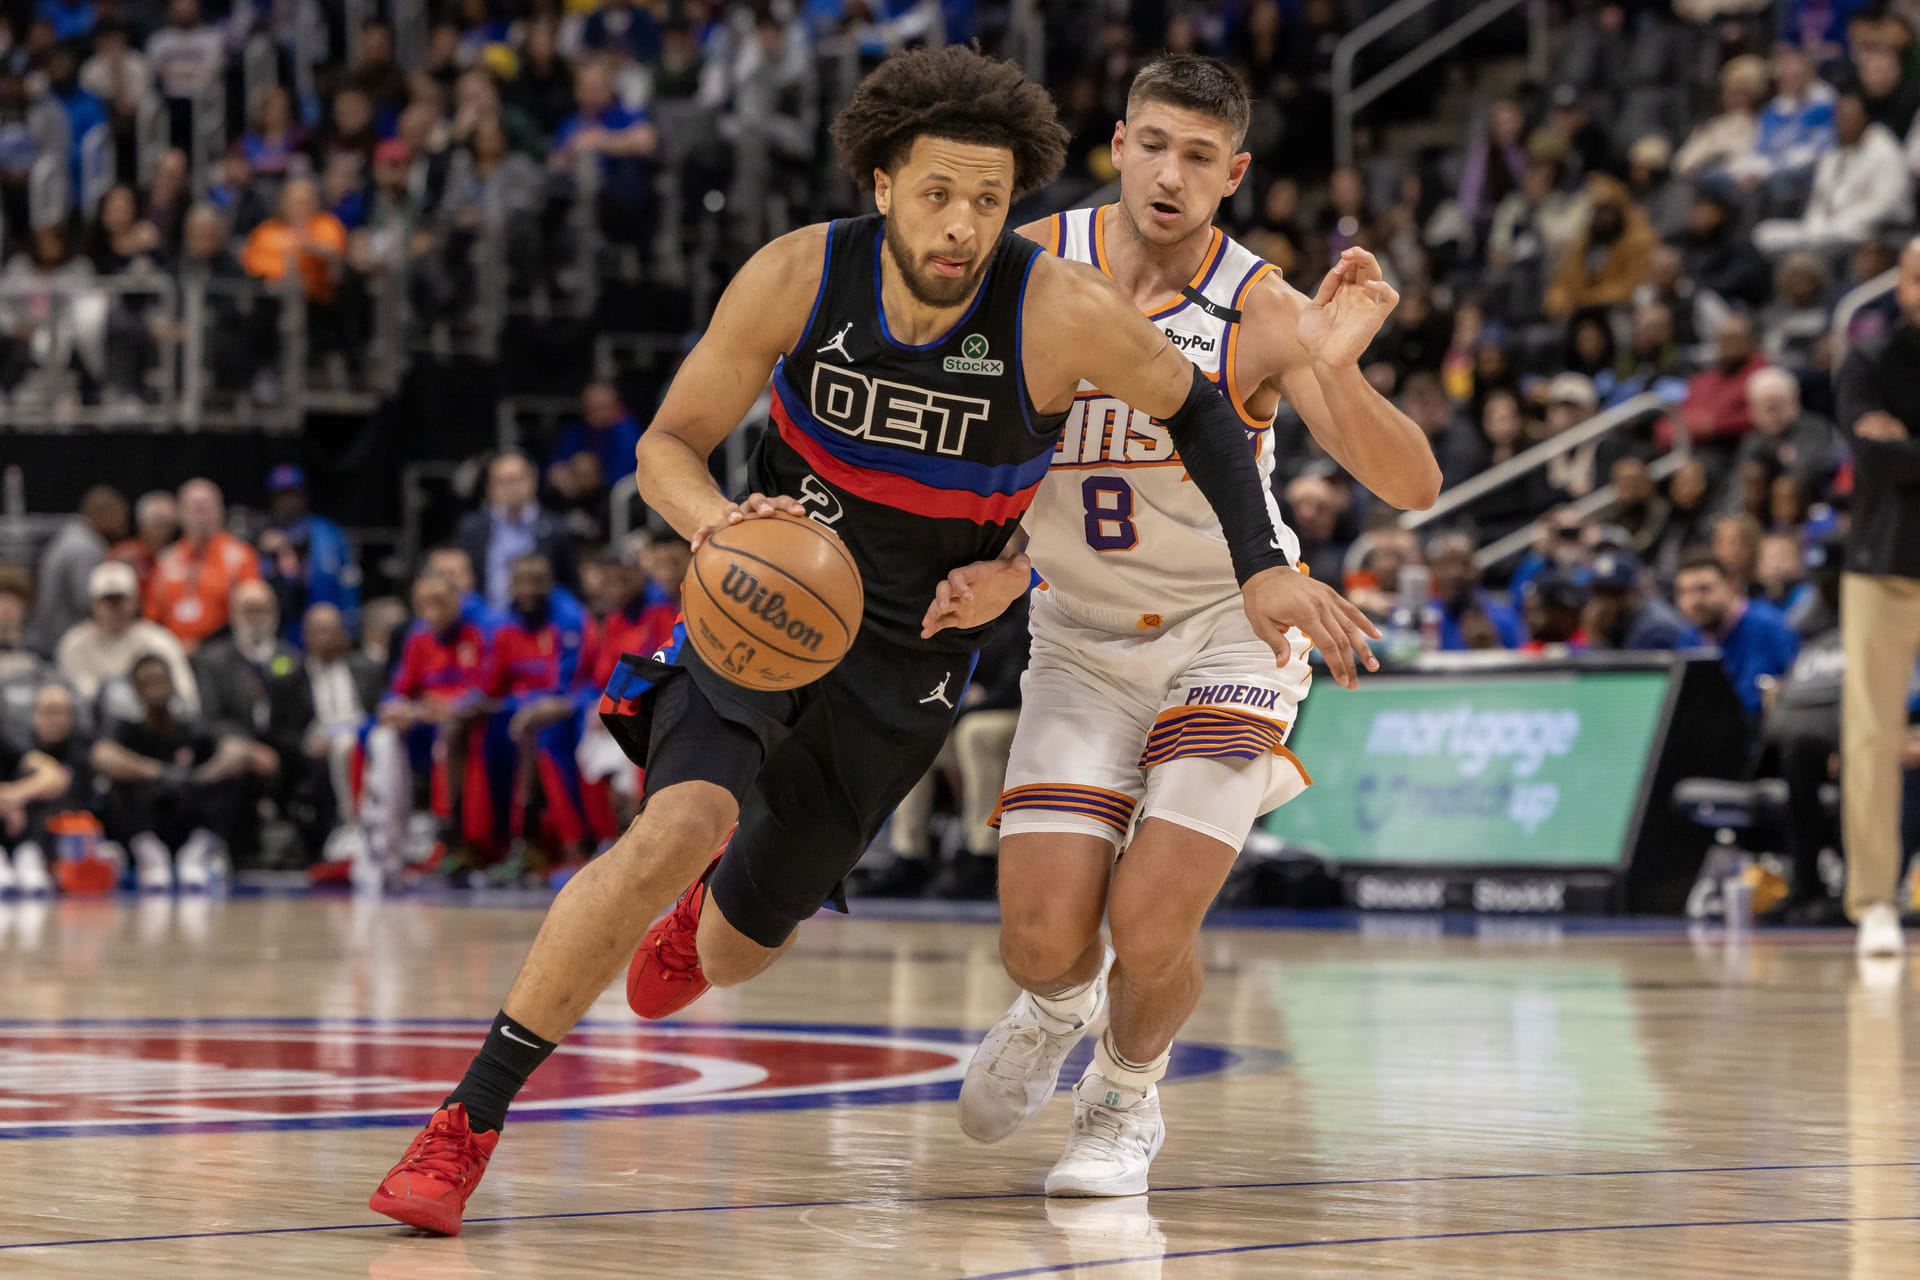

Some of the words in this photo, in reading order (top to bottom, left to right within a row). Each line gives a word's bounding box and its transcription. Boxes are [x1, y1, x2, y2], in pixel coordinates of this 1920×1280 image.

[1204, 303, 1217, 314] AL
[945, 358, 1002, 373] StockX
[1164, 328, 1216, 352] PayPal
[811, 361, 991, 456] DET
[799, 474, 844, 534] 2
[1081, 475, 1139, 553] 8
[720, 562, 825, 652] Wilson
[1184, 684, 1281, 711] PHOENIX
[1366, 702, 1581, 778] mortgage
